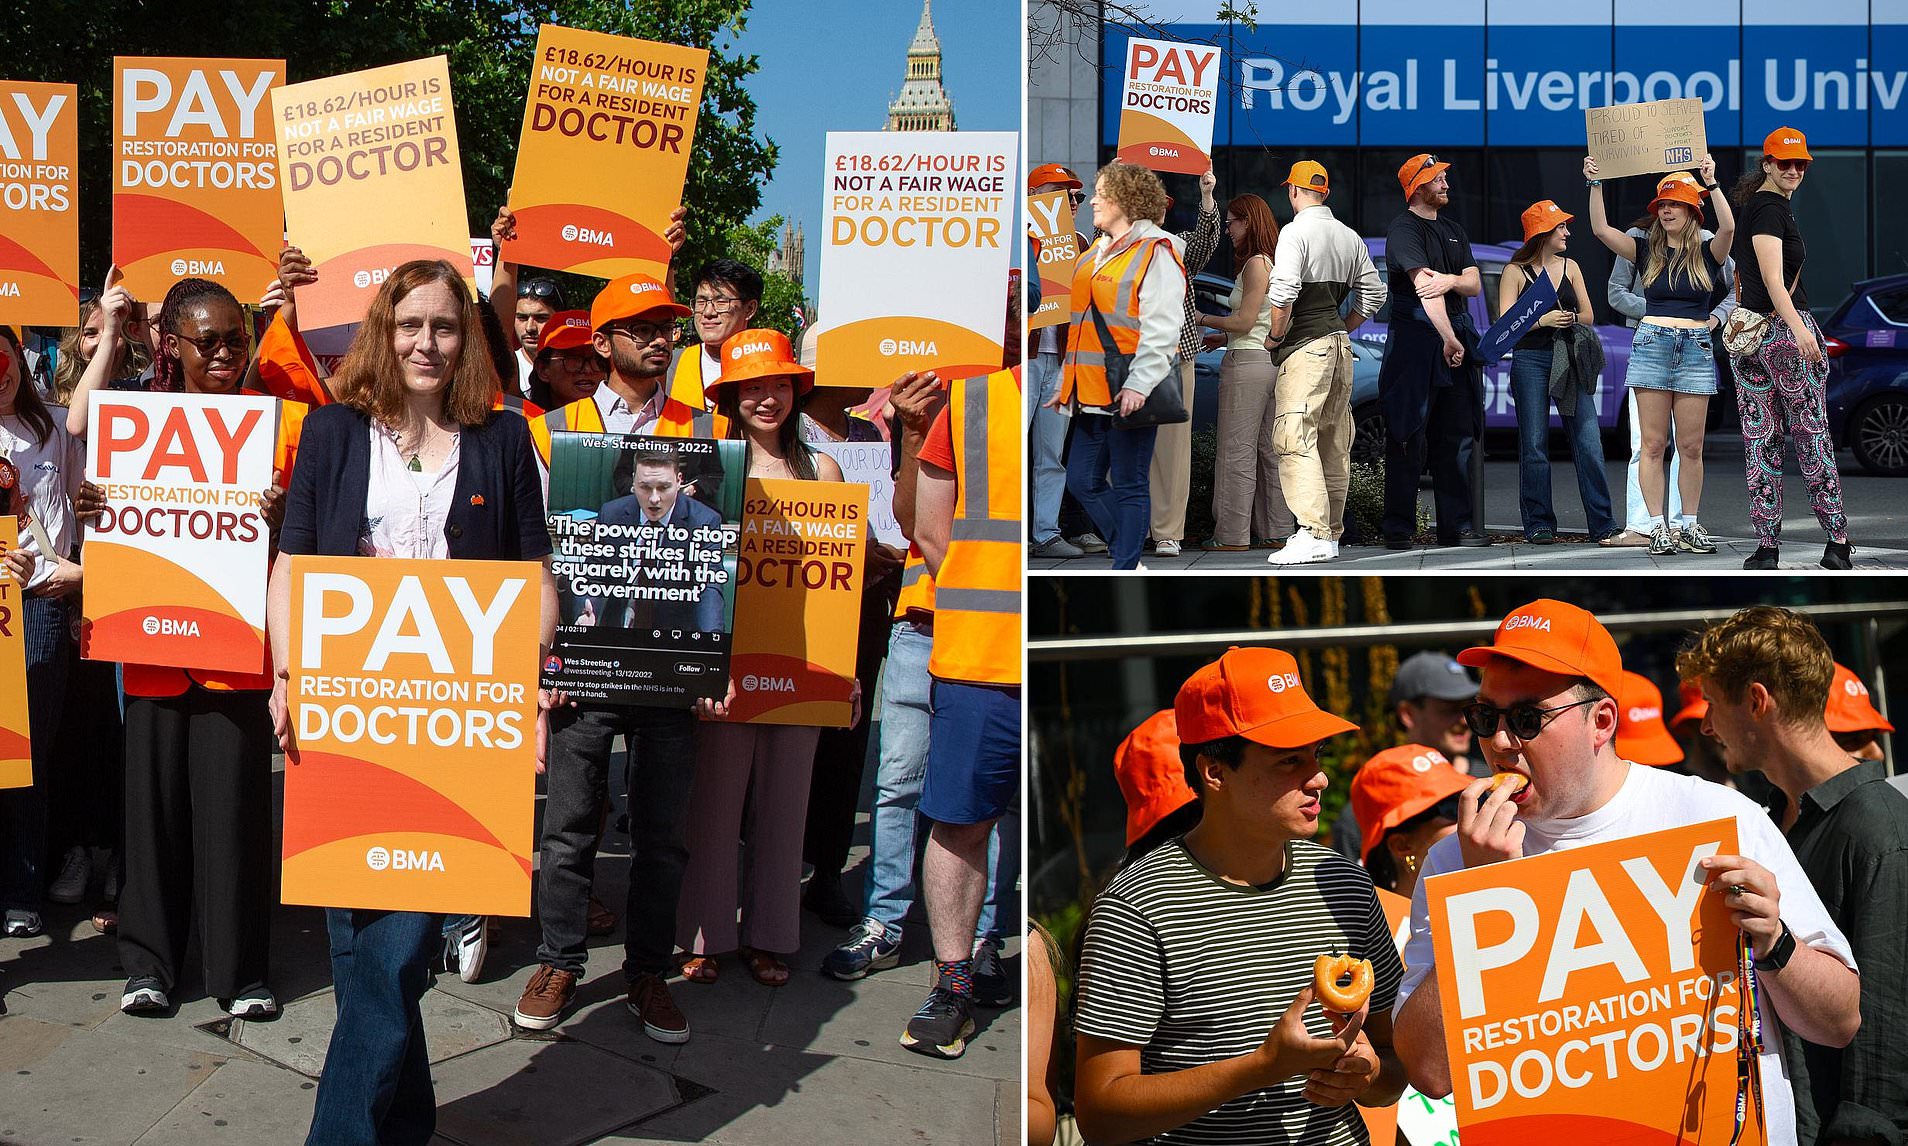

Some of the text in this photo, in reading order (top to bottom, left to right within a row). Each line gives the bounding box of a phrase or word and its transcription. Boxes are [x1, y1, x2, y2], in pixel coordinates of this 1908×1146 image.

[545, 46, 696, 84] £18.62/HOUR IS
[1130, 43, 1215, 87] PAY
[540, 65, 693, 104] NOT A FAIR WAGE
[1128, 82, 1212, 98] RESTORATION FOR
[1241, 58, 1418, 125] Royal
[1443, 58, 1741, 111] Liverpool
[122, 68, 276, 138] PAY
[283, 77, 441, 122] £18.62/HOUR IS
[537, 84, 690, 121] FOR A RESIDENT
[1127, 92, 1210, 115] DOCTORS
[284, 97, 443, 141] NOT A FAIR WAGE
[1590, 101, 1699, 126] PROUD TO SERVE
[287, 116, 445, 159] FOR A RESIDENT
[531, 103, 684, 154] DOCTOR
[1591, 125, 1648, 146] TIRED OF
[122, 141, 276, 158] RESTORATION FOR
[1158, 148, 1179, 158] BMA
[1595, 146, 1649, 161] SURVIVING
[1665, 148, 1691, 163] NHS
[36, 165, 69, 180] FOR
[289, 136, 449, 192] DOCTOR
[835, 153, 1005, 172] £18.62/HOUR IS
[122, 160, 276, 190] DOCTORS
[834, 176, 1004, 192] NOT A FAIR WAGE
[833, 195, 1003, 212] FOR A RESIDENT
[579, 228, 614, 248] BMA
[831, 215, 1001, 248] DOCTOR
[1054, 234, 1072, 245] FOR
[188, 260, 225, 275] BMA
[1039, 301, 1059, 312] BMA
[1510, 300, 1543, 332] BMA
[743, 341, 773, 355] BMA
[898, 340, 938, 356] BMA
[96, 403, 264, 484] PAY
[582, 437, 713, 454] Wes Streeting, 2022:
[872, 448, 891, 470] DO
[224, 490, 262, 507] FOR
[745, 499, 859, 520] 62/HOUR IS
[95, 506, 259, 543] DOCTORS
[745, 519, 857, 539] A FAIR WAGE
[594, 523, 664, 542] power
[667, 523, 689, 541] to
[692, 526, 737, 548] stop
[560, 538, 722, 563] these strikes lies
[744, 539, 856, 558] A RESIDENT
[551, 558, 728, 584] squarely with the
[161, 619, 200, 637] BMA
[301, 572, 527, 675] PAY
[1517, 615, 1551, 632] BMA
[580, 658, 612, 669] Streeting
[678, 664, 701, 673] Follow
[300, 675, 524, 704] RESTORATION FOR
[542, 678, 554, 686] The
[555, 680, 576, 688] power
[585, 682, 600, 690] stop
[601, 682, 623, 690] strikes
[643, 684, 659, 692] NHS
[666, 685, 673, 693] in
[586, 689, 609, 698] hands.
[760, 676, 795, 692] BMA
[299, 703, 523, 749] DOCTORS
[392, 849, 446, 872] BMA
[1445, 841, 1721, 1020] PAY
[1463, 970, 1736, 1054] RESTORATION FOR
[1752, 1020, 1761, 1039] BMA
[1467, 1005, 1738, 1111] DOCTORS
[1738, 1092, 1746, 1113] BMA
